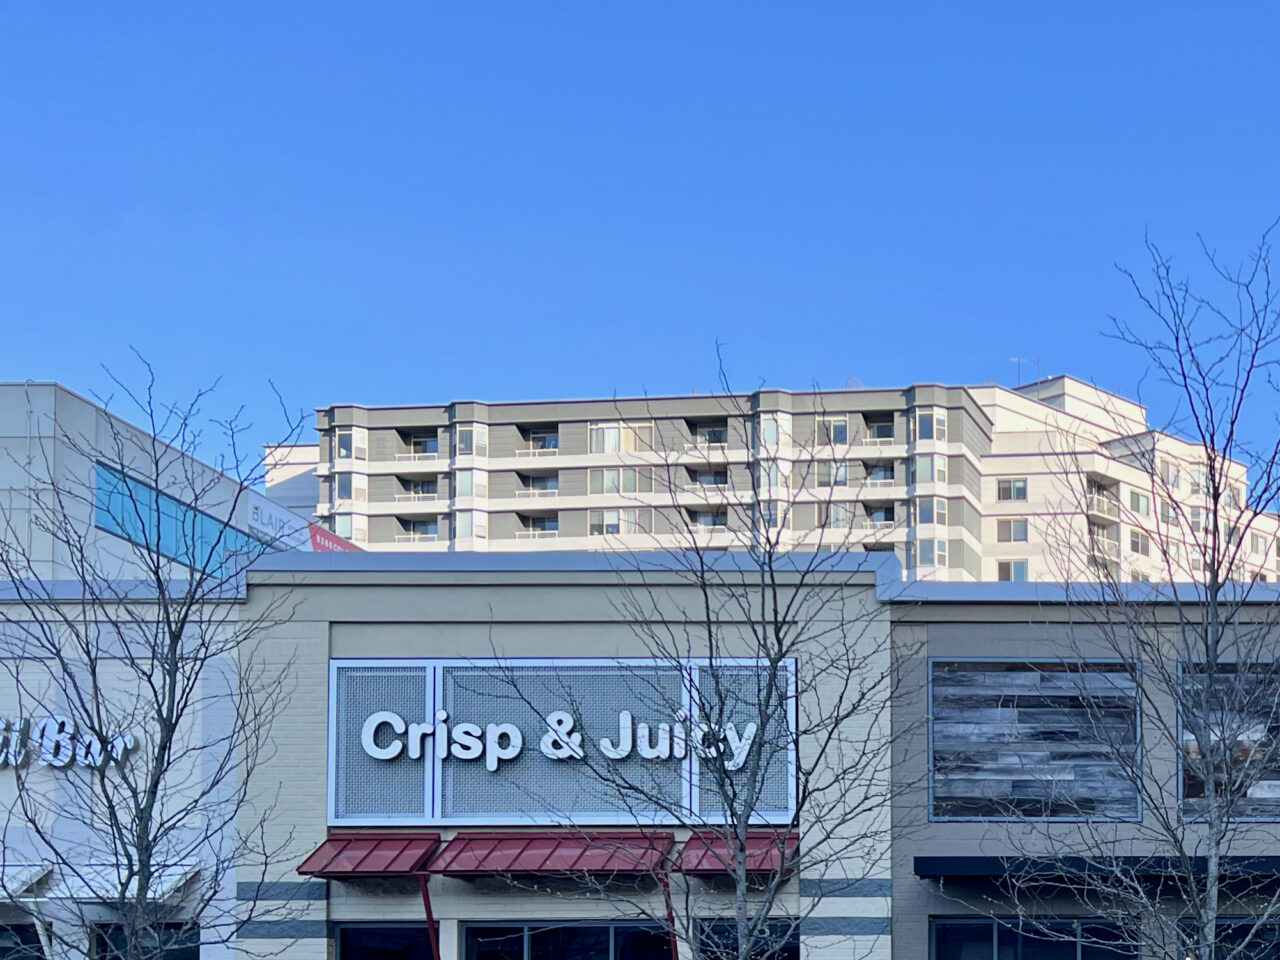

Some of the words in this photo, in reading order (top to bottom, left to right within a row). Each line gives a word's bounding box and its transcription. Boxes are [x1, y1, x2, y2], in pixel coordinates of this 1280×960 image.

[361, 709, 522, 772] Crisp
[540, 710, 584, 760] &
[600, 709, 758, 771] Juicy
